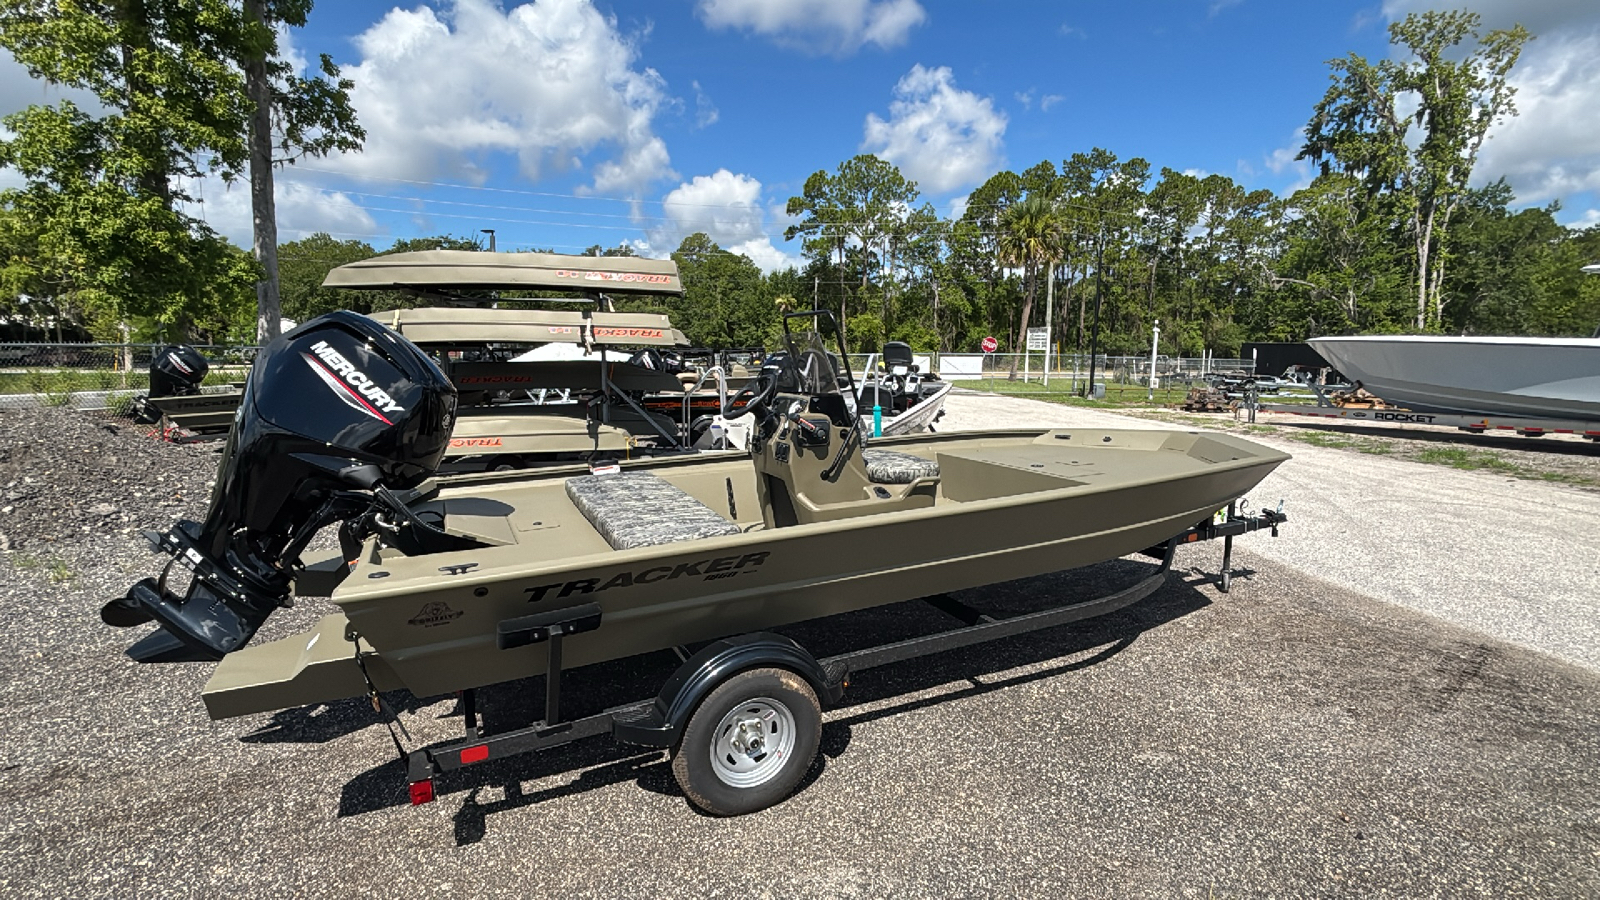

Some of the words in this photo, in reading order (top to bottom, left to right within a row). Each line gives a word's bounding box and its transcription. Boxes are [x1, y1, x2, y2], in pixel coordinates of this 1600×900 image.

[577, 326, 663, 338] TRACKE
[982, 339, 997, 349] STOP
[309, 340, 406, 413] MERCURY
[459, 375, 534, 384] TRACKER
[1374, 412, 1436, 423] ROCKET
[523, 551, 771, 602] TRACKER
